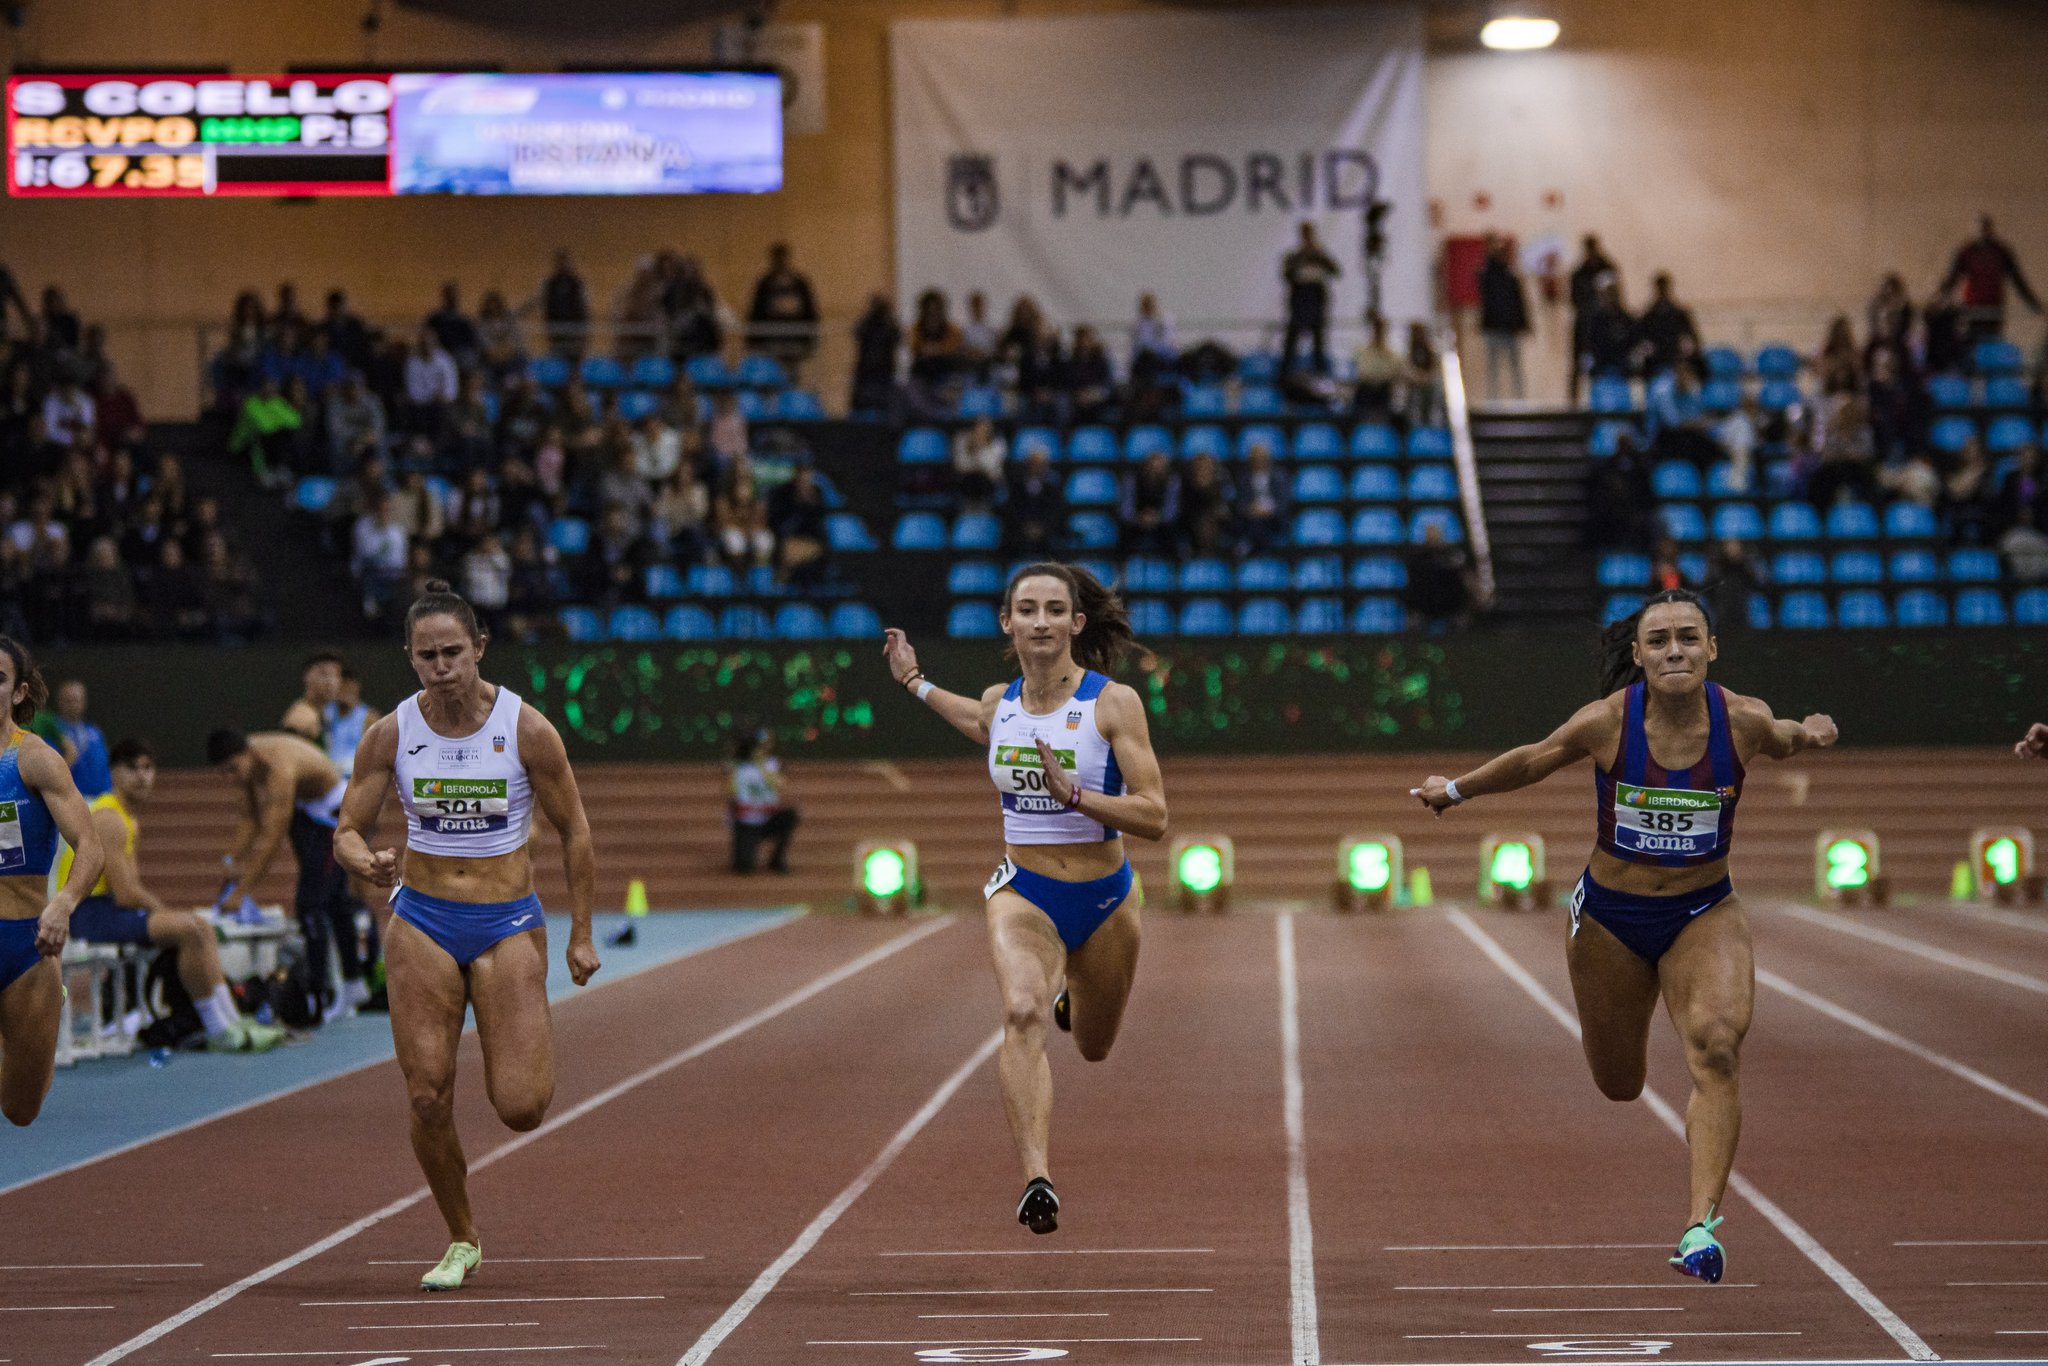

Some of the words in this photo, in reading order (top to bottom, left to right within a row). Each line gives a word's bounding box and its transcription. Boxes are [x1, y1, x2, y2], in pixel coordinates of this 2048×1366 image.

[12, 81, 66, 115] S
[84, 80, 392, 116] COELLO
[1051, 149, 1381, 220] MADRID
[443, 785, 498, 794] IBERDROLA
[1648, 796, 1710, 807] IBERDROLA
[437, 800, 481, 814] 501
[1639, 811, 1694, 832] 385
[1826, 838, 1868, 887] 2
[1985, 837, 2018, 885] 1
